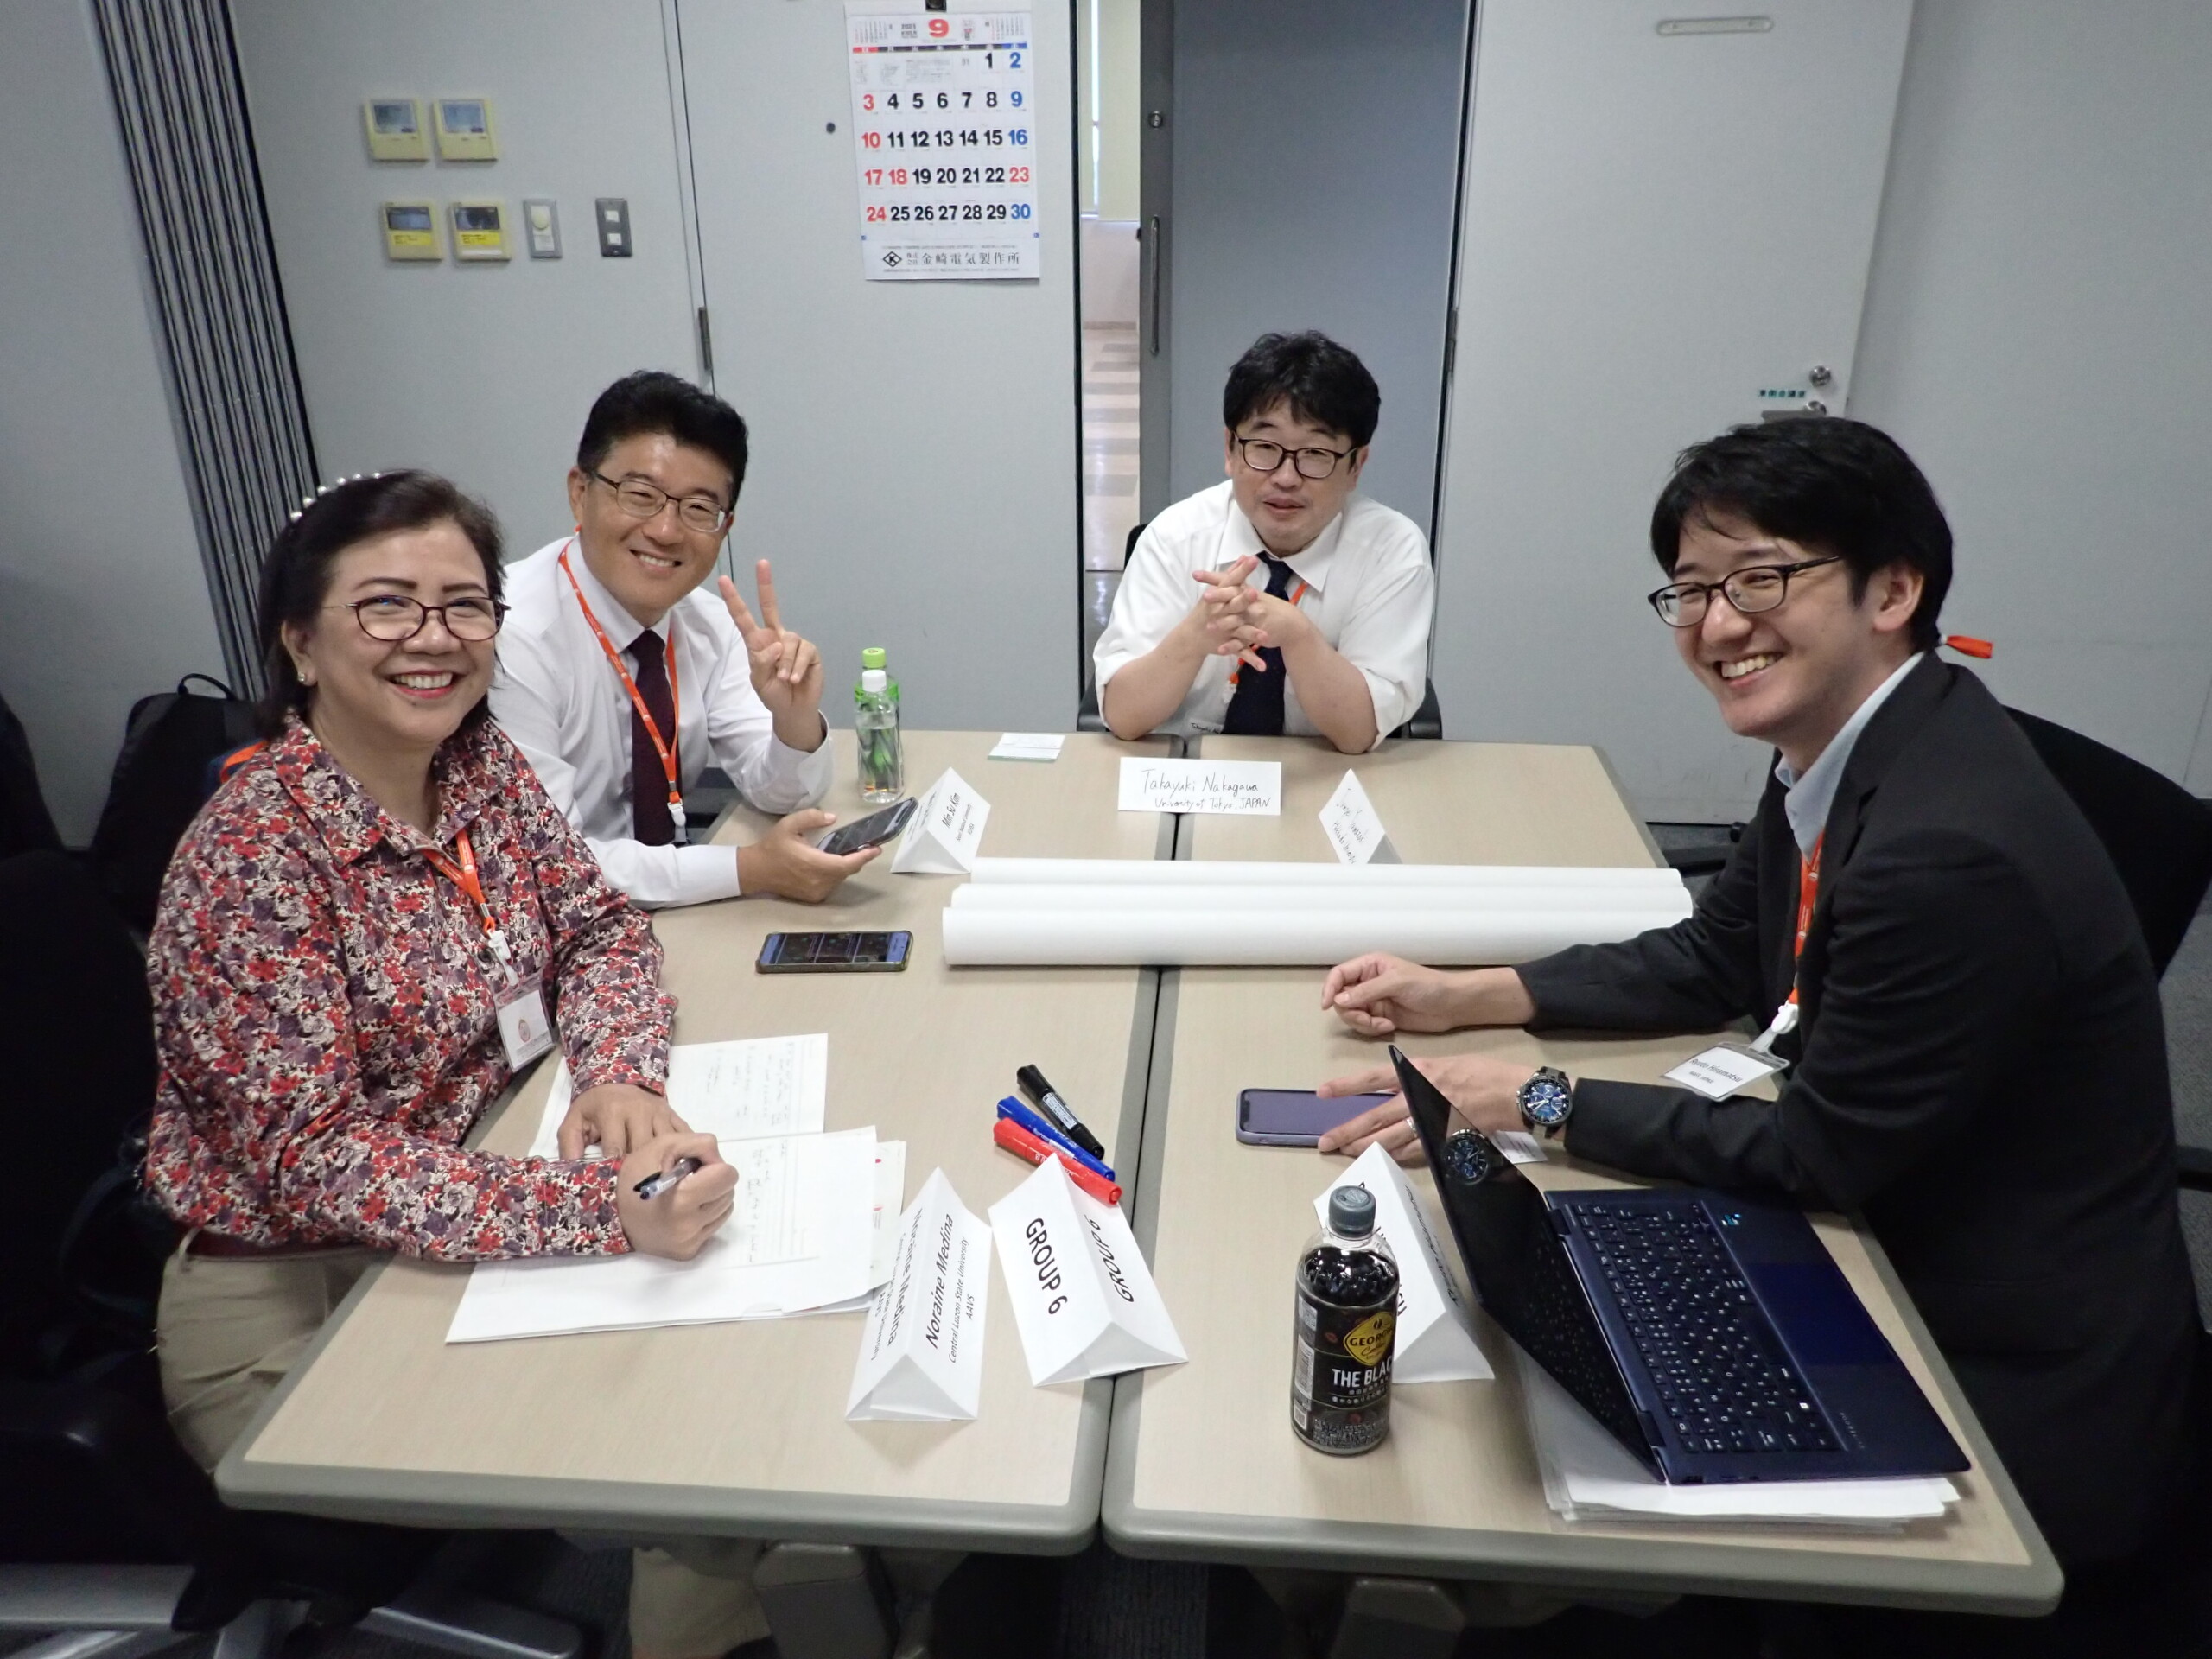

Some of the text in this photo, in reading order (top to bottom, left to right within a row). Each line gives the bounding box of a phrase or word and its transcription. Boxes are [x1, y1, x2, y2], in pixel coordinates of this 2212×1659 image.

[928, 18, 949, 38] 9
[985, 52, 993, 69] 1
[1009, 52, 1021, 69] 2
[863, 91, 1023, 111] 3 4 5 6 7 8 9
[861, 129, 1028, 149] 10 11 12 13 14 15 16
[865, 167, 1030, 185] 17 18 19 20 21 22 23
[867, 204, 1031, 222] 24 25 26 27 28 29 30
[1141, 768, 1259, 799] Takayuki Nakagawa
[1238, 797, 1272, 810] JAPAN
[1026, 1217, 1068, 1315] GROUP 6
[1084, 1213, 1135, 1303] GROUP 6
[925, 1213, 954, 1350] Noraine Medina
[949, 1236, 970, 1363] Central Luzon State University
[966, 1293, 976, 1321] AAVS
[887, 1273, 912, 1347] Medina
[1332, 1368, 1362, 1388] THE
